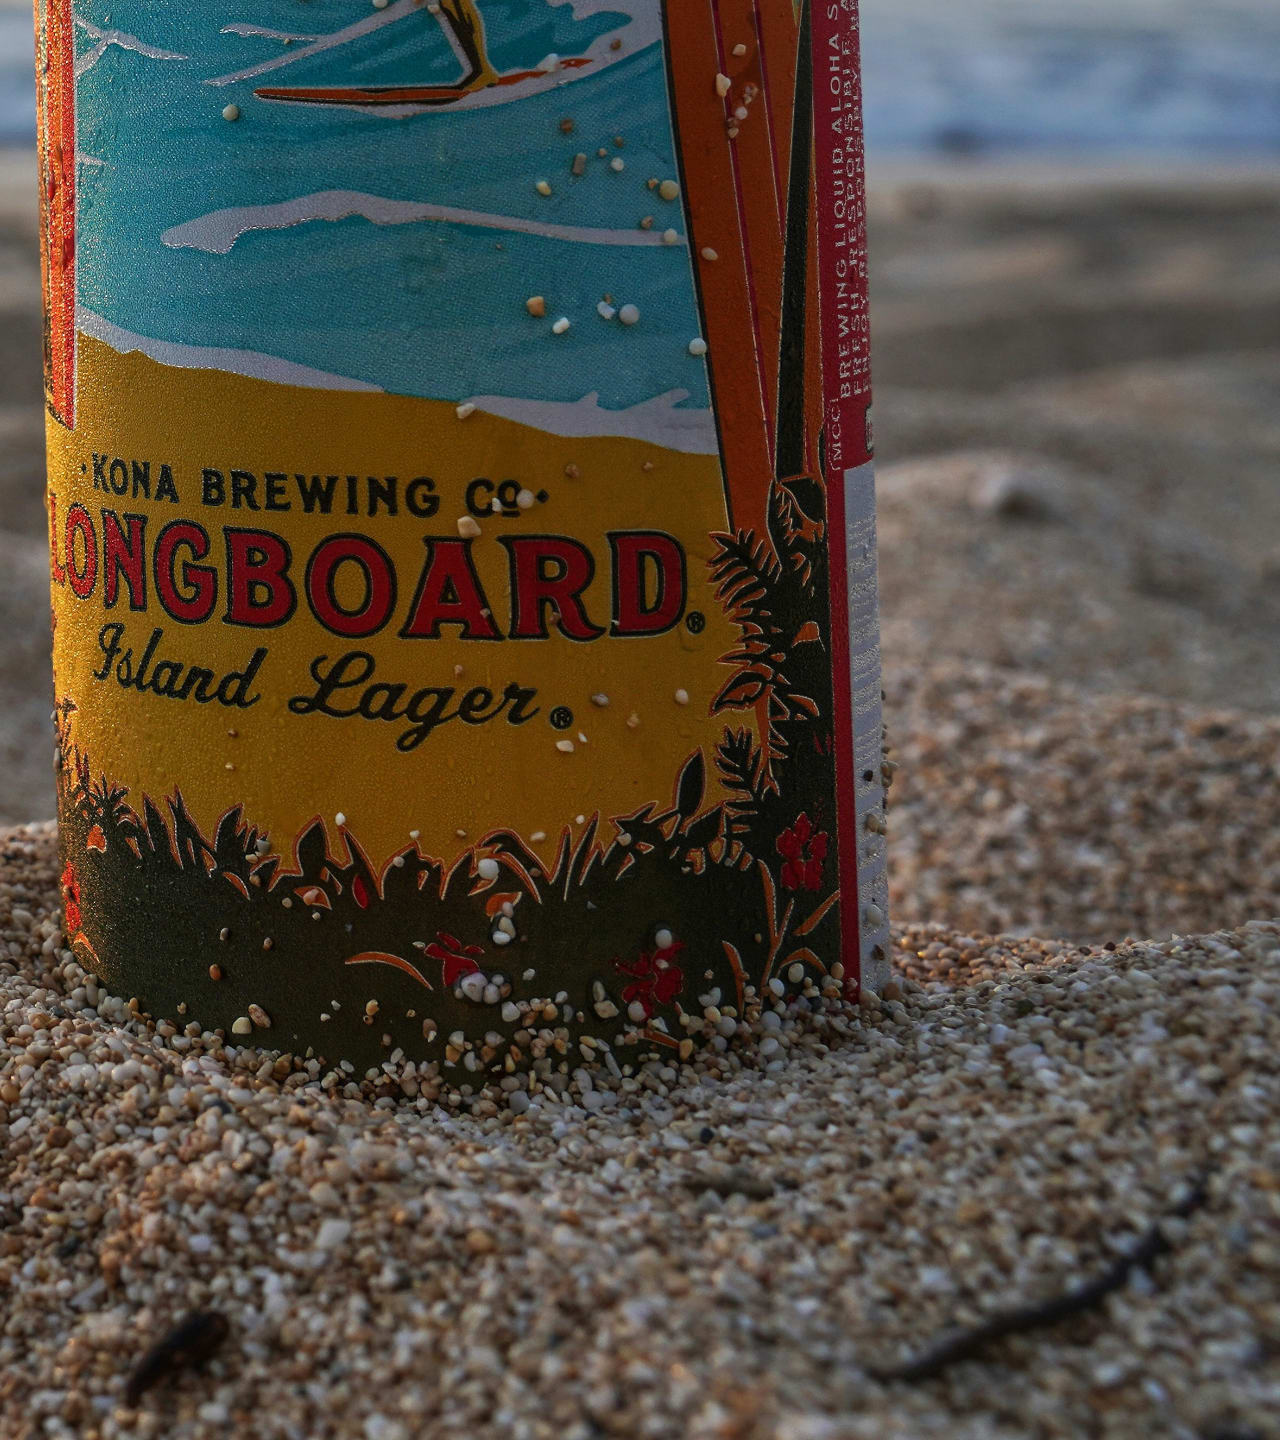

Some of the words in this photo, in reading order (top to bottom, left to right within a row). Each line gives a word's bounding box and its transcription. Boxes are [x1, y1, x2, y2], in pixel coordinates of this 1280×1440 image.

[828, 33, 842, 135] ALOHA
[832, 148, 848, 247] LIQUID
[836, 259, 852, 399] BREWING
[92, 451, 180, 504] KONA
[202, 467, 440, 519] BREWING
[91, 622, 268, 709] Island
